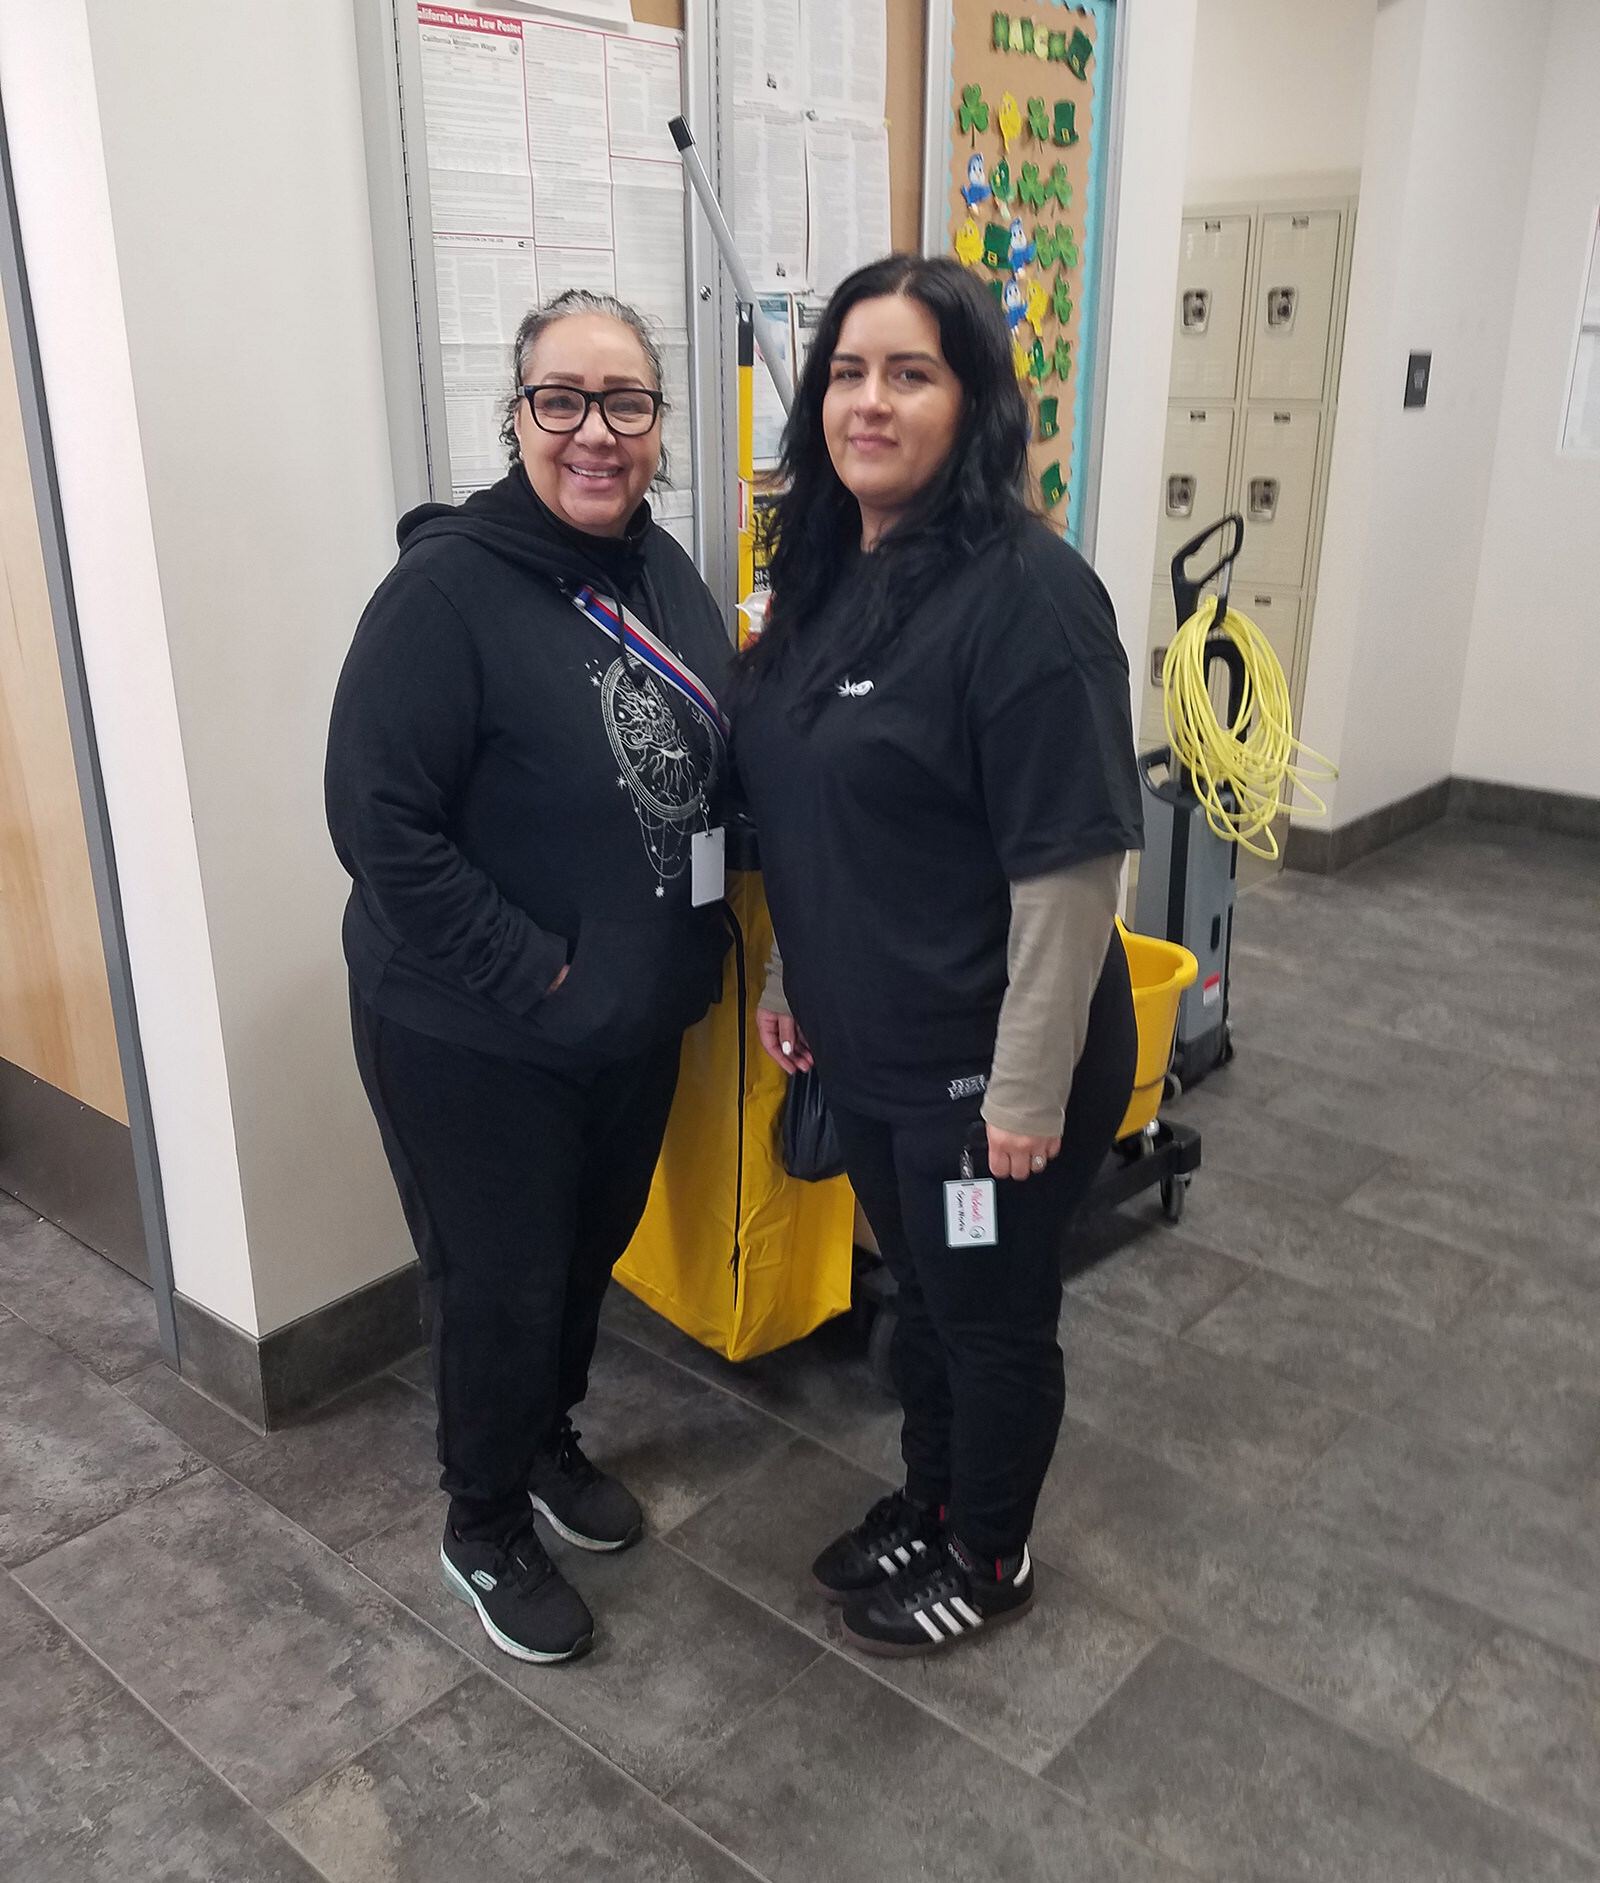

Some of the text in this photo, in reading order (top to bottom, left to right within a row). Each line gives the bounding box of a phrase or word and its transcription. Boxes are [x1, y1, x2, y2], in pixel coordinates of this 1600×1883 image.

[418, 8, 454, 24] alifornia
[455, 13, 478, 27] Labor
[480, 17, 496, 30] Law
[497, 20, 521, 34] Poster
[422, 34, 452, 45] California
[452, 39, 480, 48] Minimum
[480, 43, 497, 52] Wage
